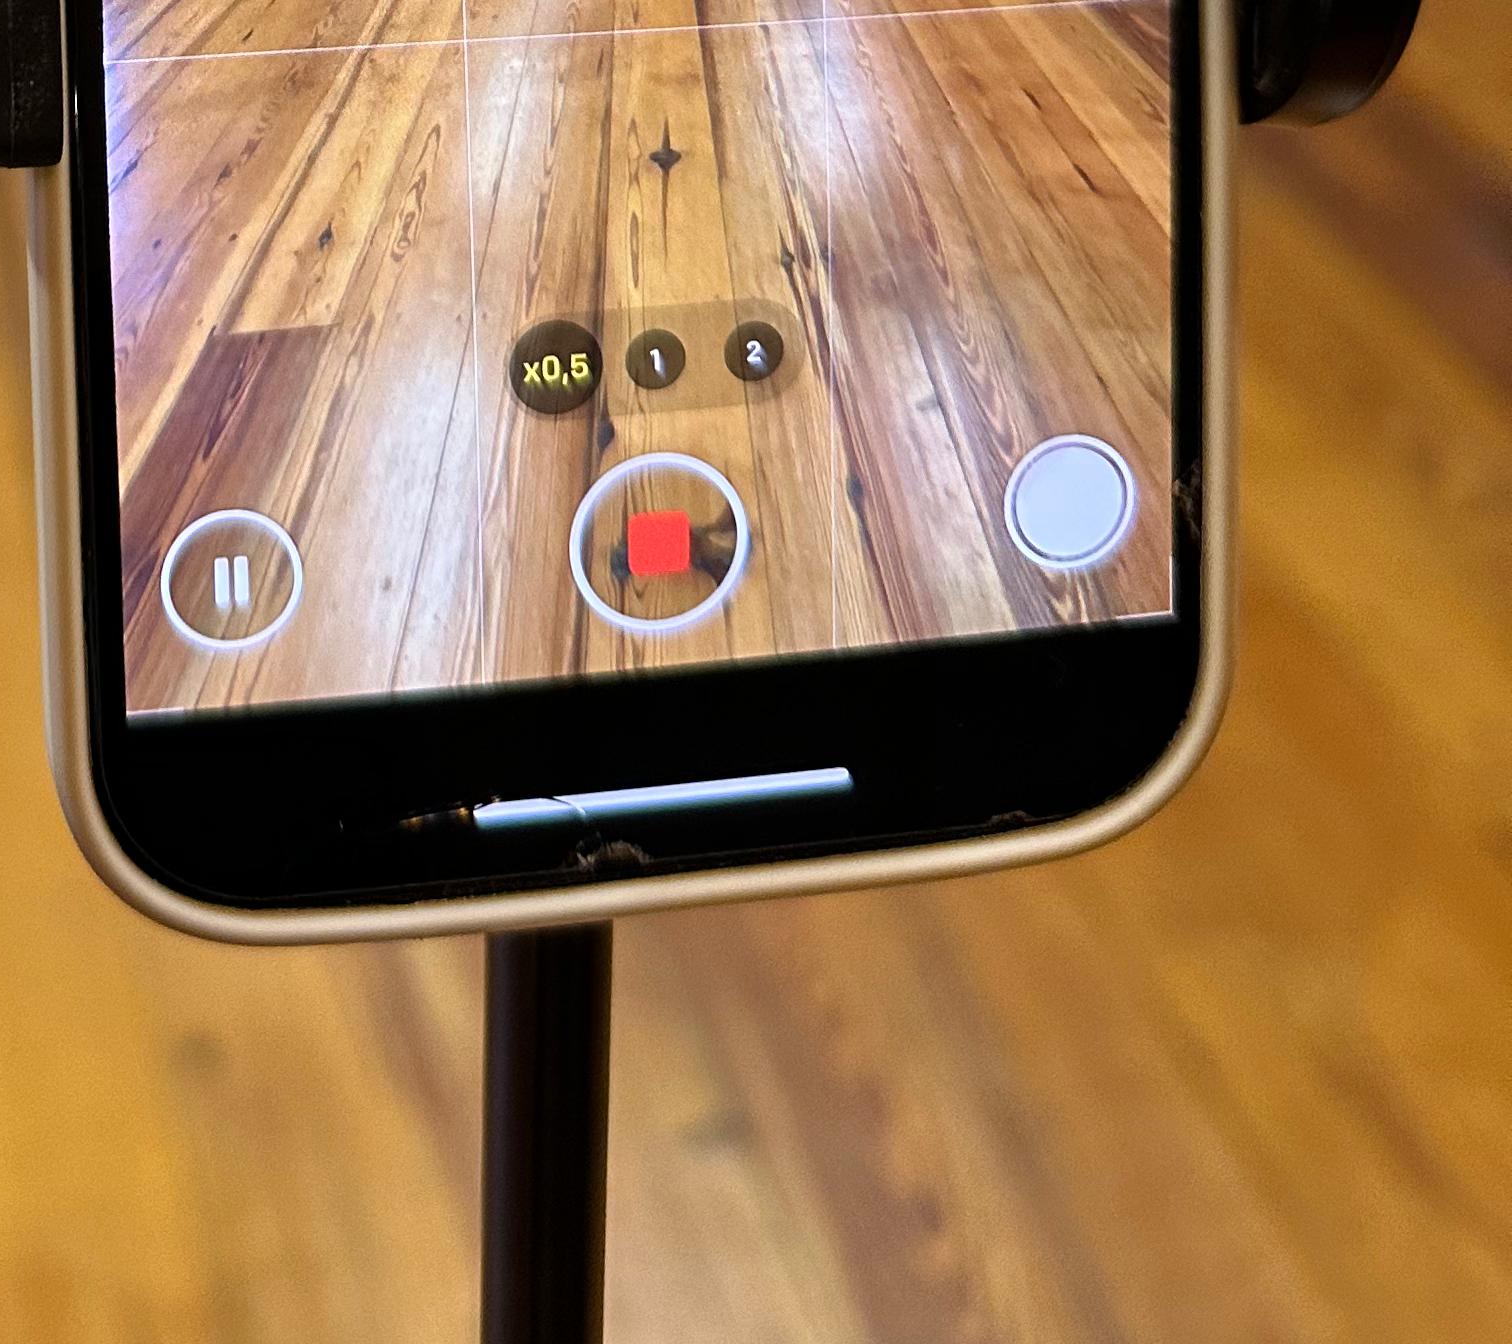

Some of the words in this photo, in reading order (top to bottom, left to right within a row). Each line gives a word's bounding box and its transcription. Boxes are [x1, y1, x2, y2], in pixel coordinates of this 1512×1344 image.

[522, 353, 589, 385] x0,5
[649, 348, 663, 374] 1
[745, 339, 763, 363] 2
